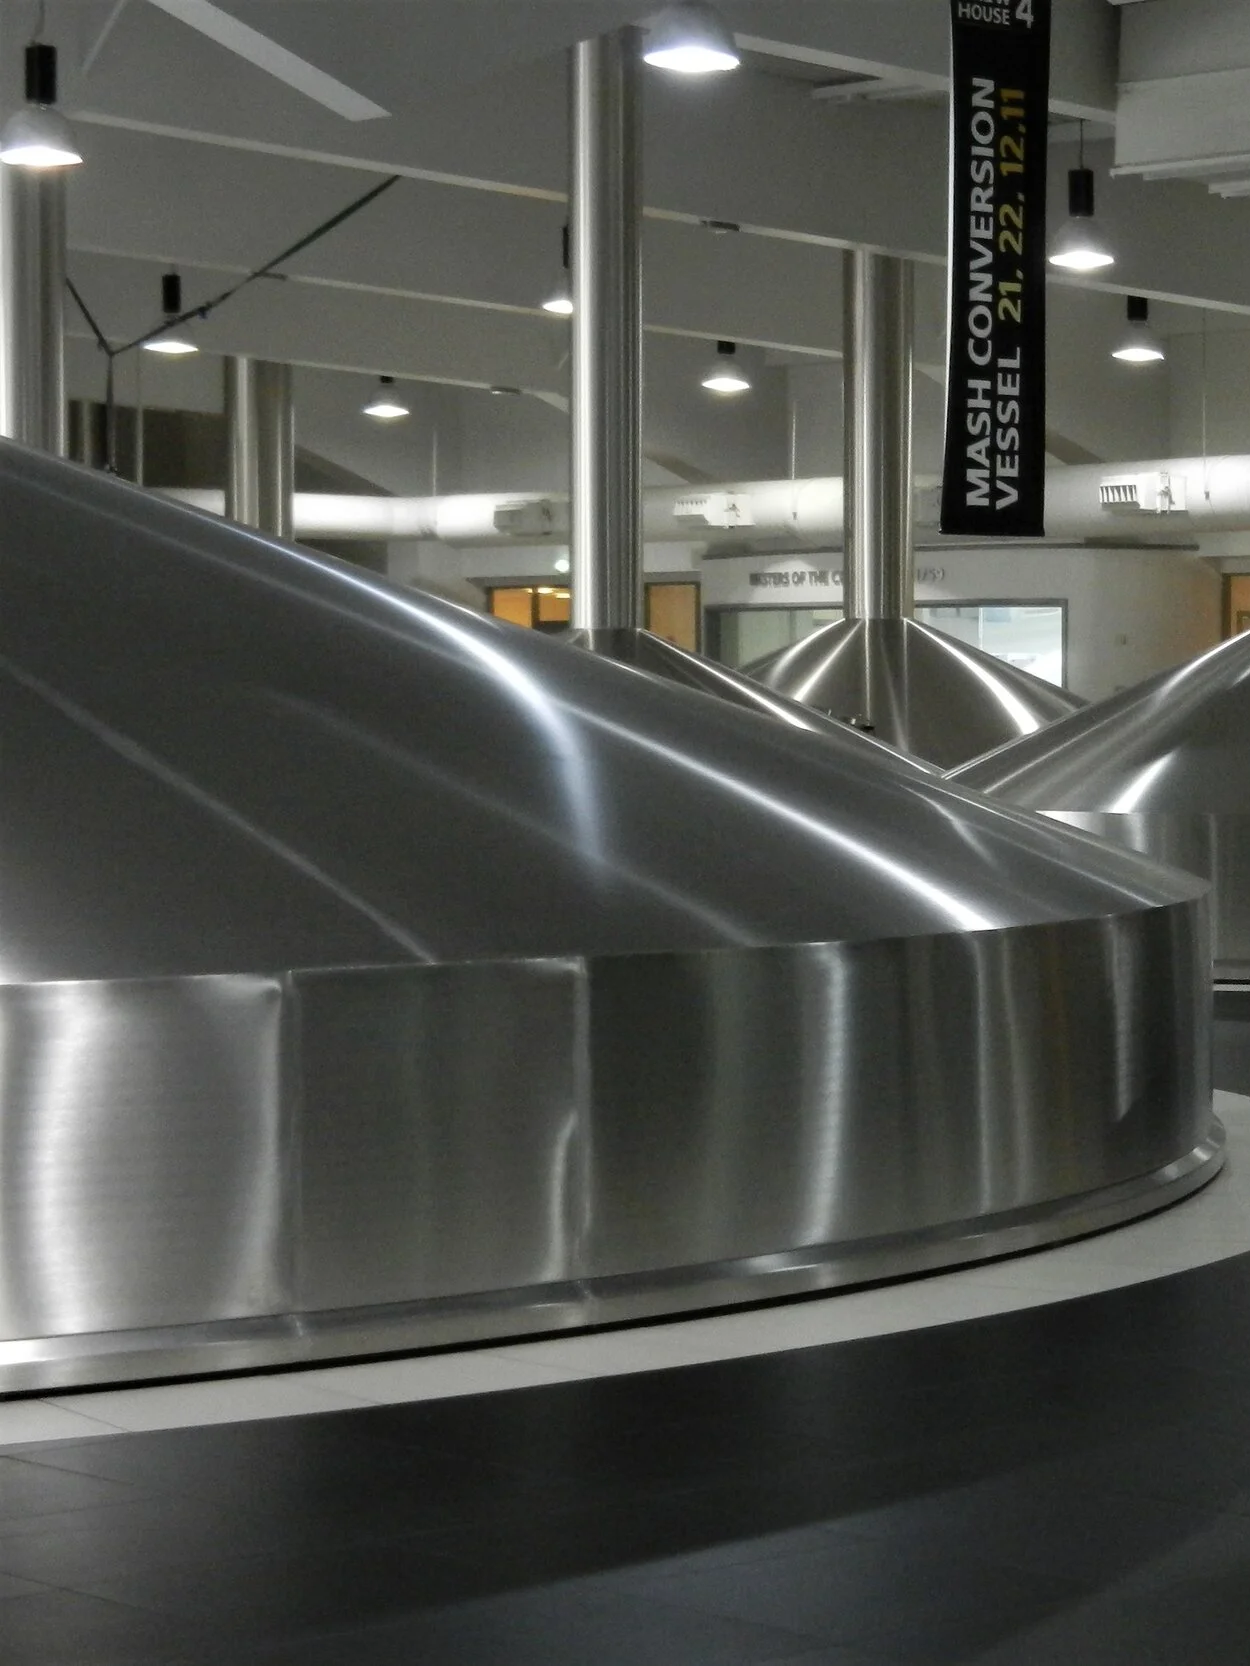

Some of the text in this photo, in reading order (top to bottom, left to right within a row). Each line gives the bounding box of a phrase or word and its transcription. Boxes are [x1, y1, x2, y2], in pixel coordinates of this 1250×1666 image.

[959, 0, 1033, 28] HOUSE 4
[967, 78, 994, 506] MASH CONVERSION
[996, 347, 1020, 509] VESSEL
